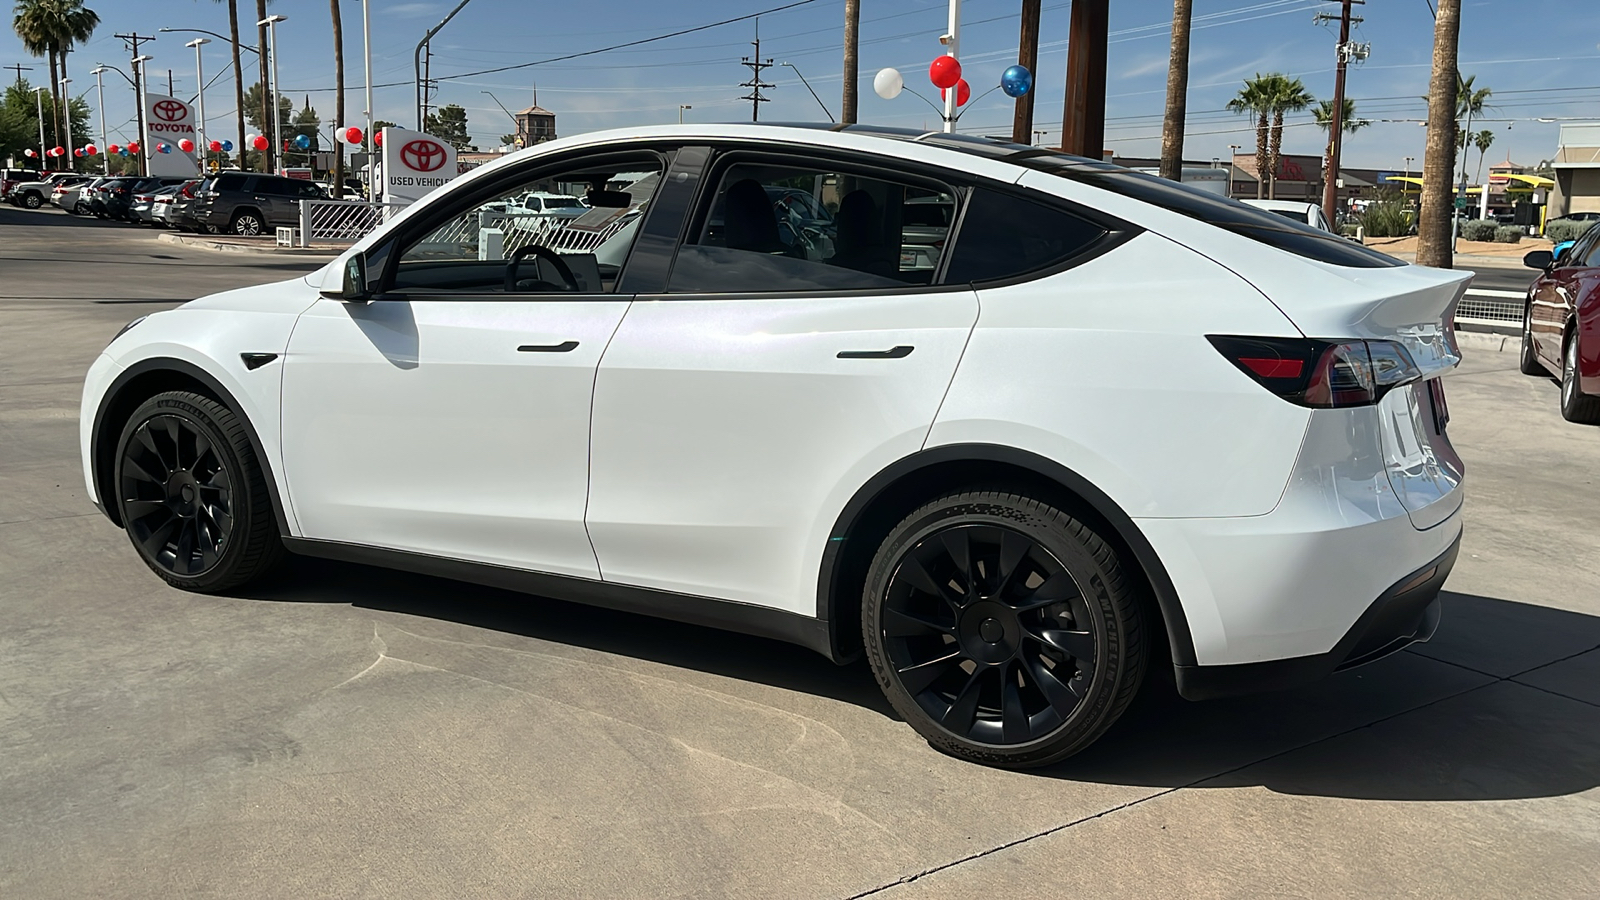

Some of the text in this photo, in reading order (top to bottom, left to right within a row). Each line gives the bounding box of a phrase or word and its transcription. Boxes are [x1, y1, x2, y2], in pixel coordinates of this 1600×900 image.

[148, 122, 195, 133] TOYOTA
[390, 176, 454, 187] USED VEHICL
[868, 591, 882, 667] MICHELIN
[1100, 598, 1118, 682] MICHELIN
